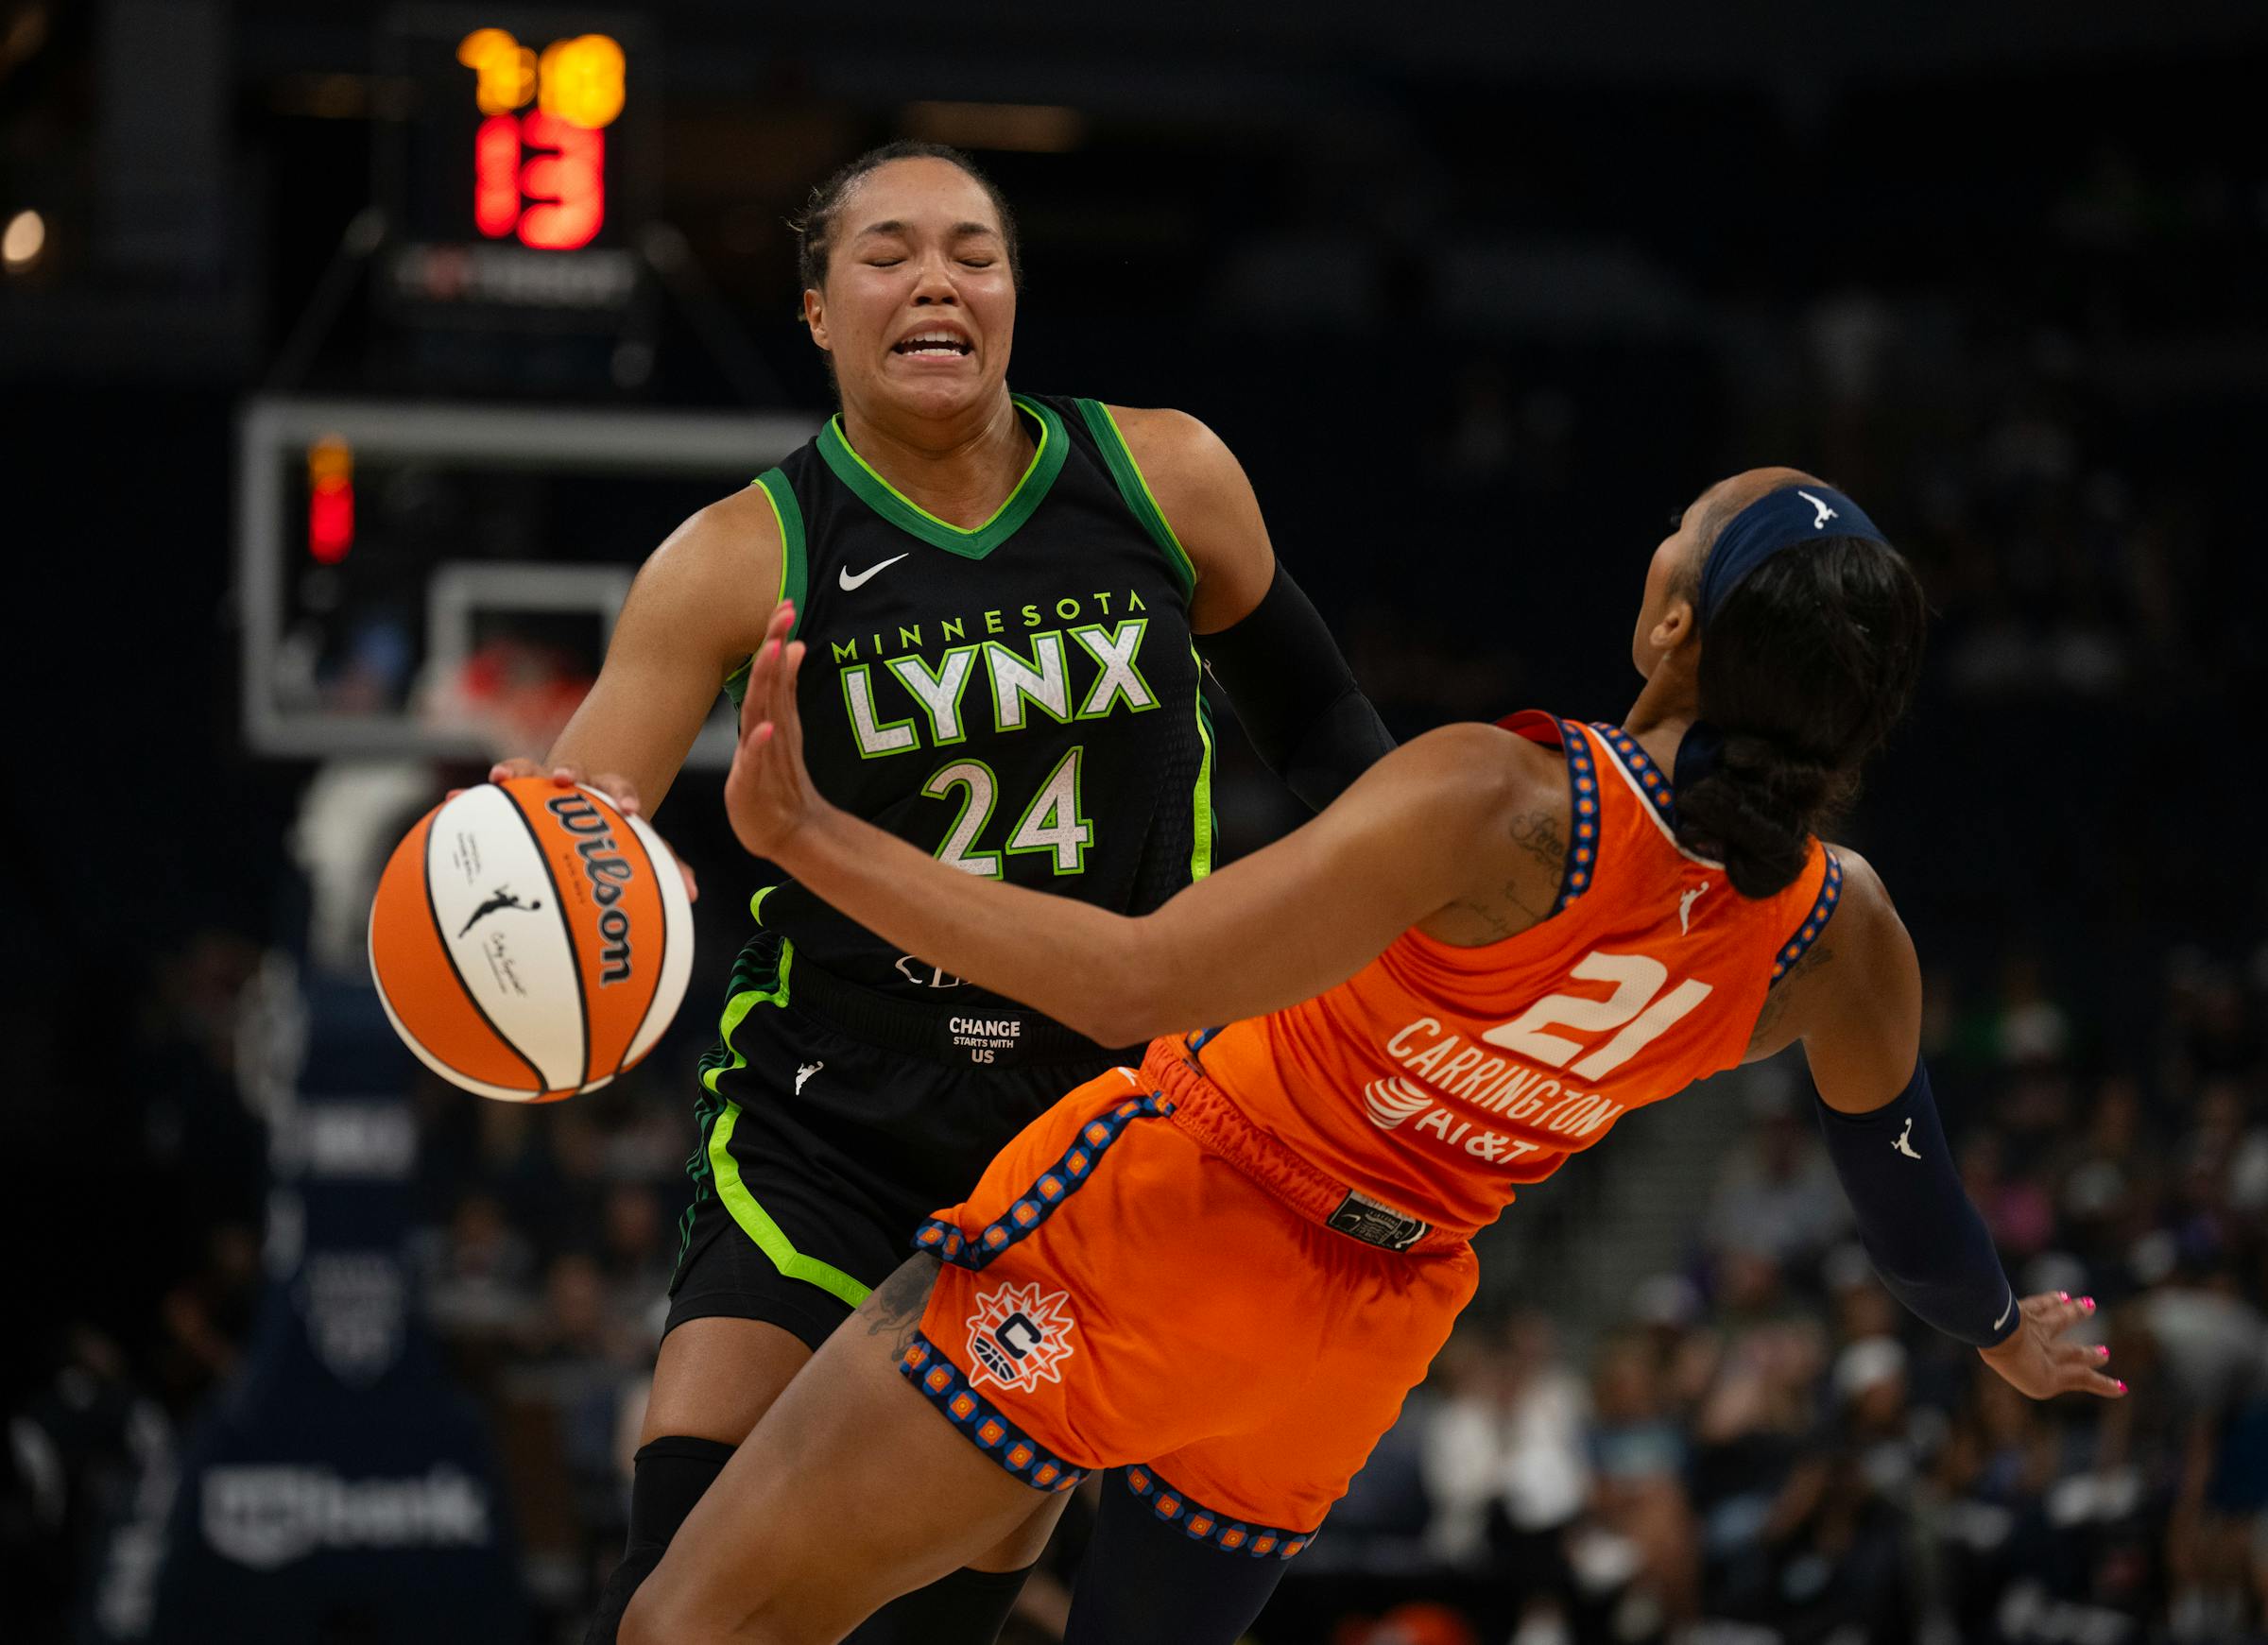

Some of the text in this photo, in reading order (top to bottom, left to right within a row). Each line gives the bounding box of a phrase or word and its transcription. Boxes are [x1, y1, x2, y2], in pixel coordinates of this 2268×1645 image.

[474, 111, 606, 250] 13
[831, 589, 1146, 663] MINNESOTA
[839, 618, 1161, 760] LYNX
[920, 745, 1093, 881] 24
[544, 792, 633, 989] Wilson
[949, 1017, 1021, 1037] CHANGE
[954, 1037, 1014, 1049] STARTS WITH
[971, 1049, 995, 1064] US
[1386, 1018, 1624, 1137] CARRINGTON
[1481, 951, 1713, 1082] 21
